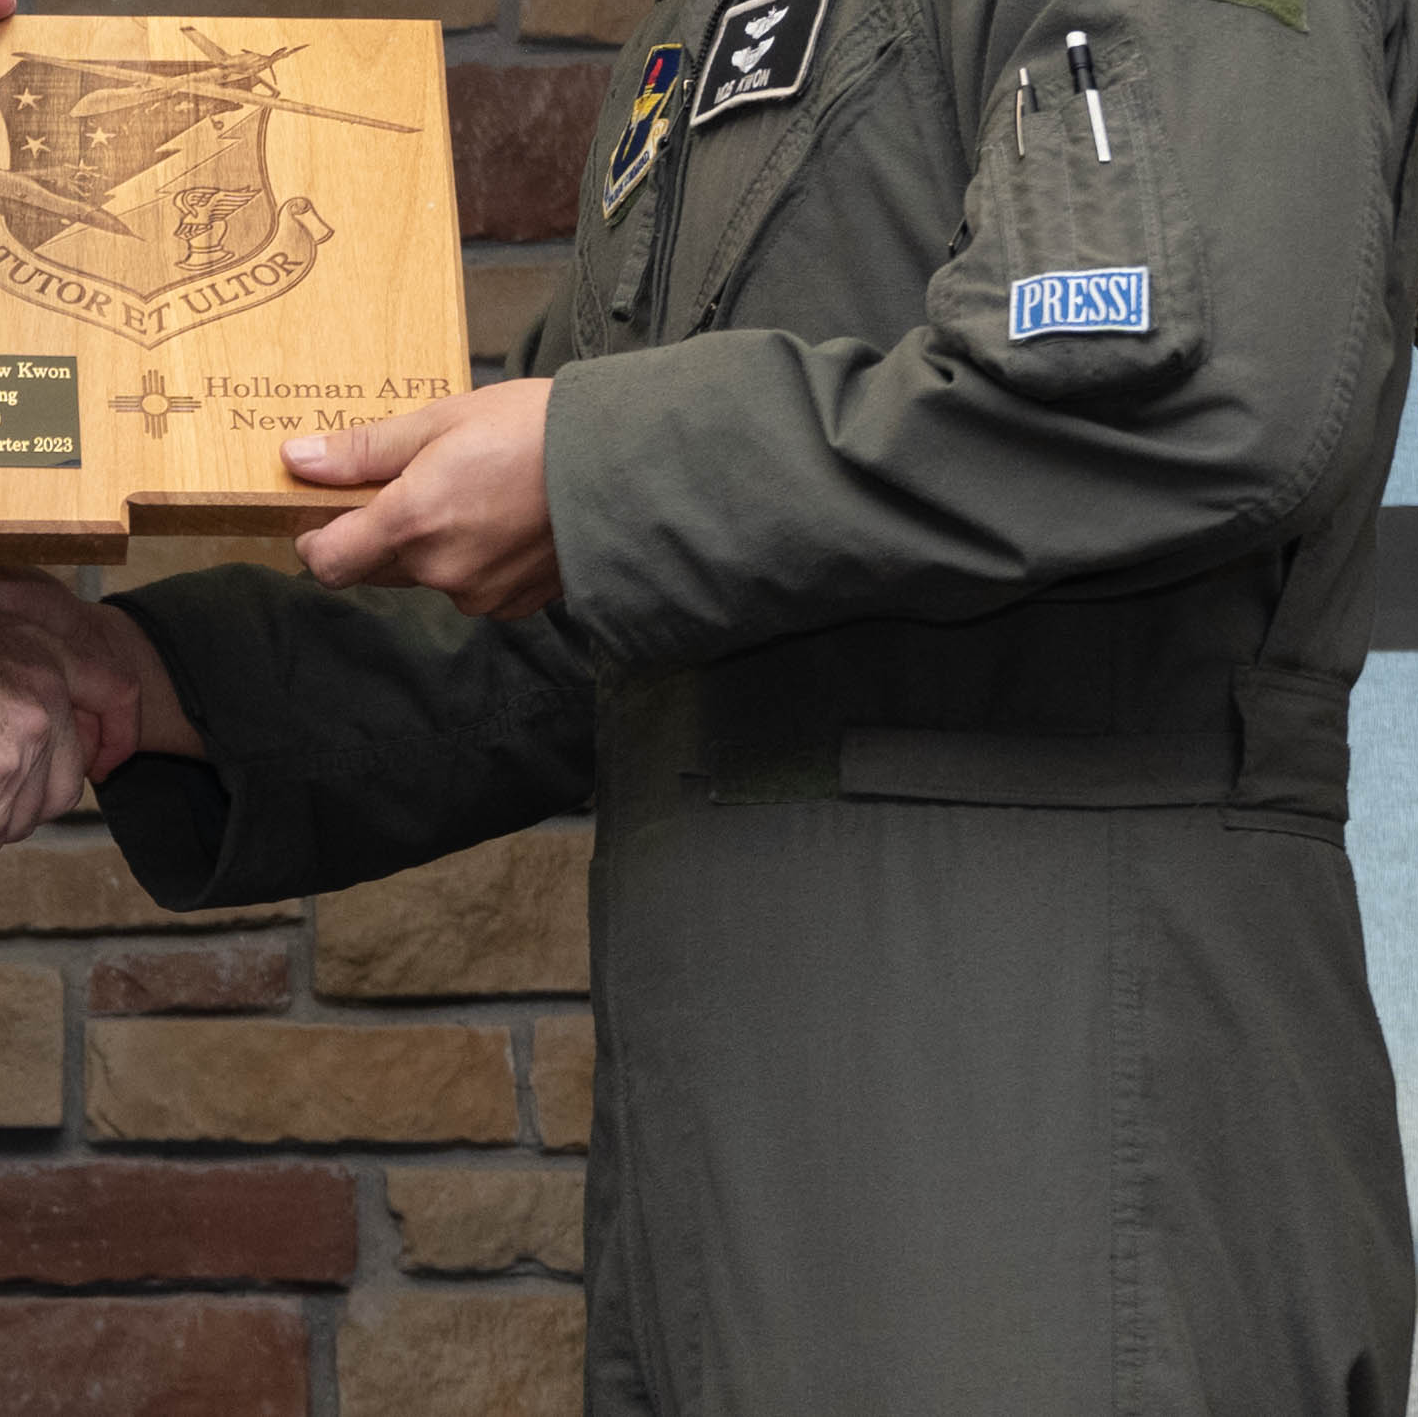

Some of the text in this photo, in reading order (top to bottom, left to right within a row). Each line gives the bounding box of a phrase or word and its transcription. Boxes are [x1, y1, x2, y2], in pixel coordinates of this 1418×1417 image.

[121, 301, 172, 336] ET
[178, 251, 304, 315] ULTOR
[1021, 275, 1137, 329] PRESS!
[17, 361, 71, 379] Kwon
[203, 376, 452, 400] Holloman AFB
[229, 408, 304, 431] New
[33, 437, 73, 453] 2023
